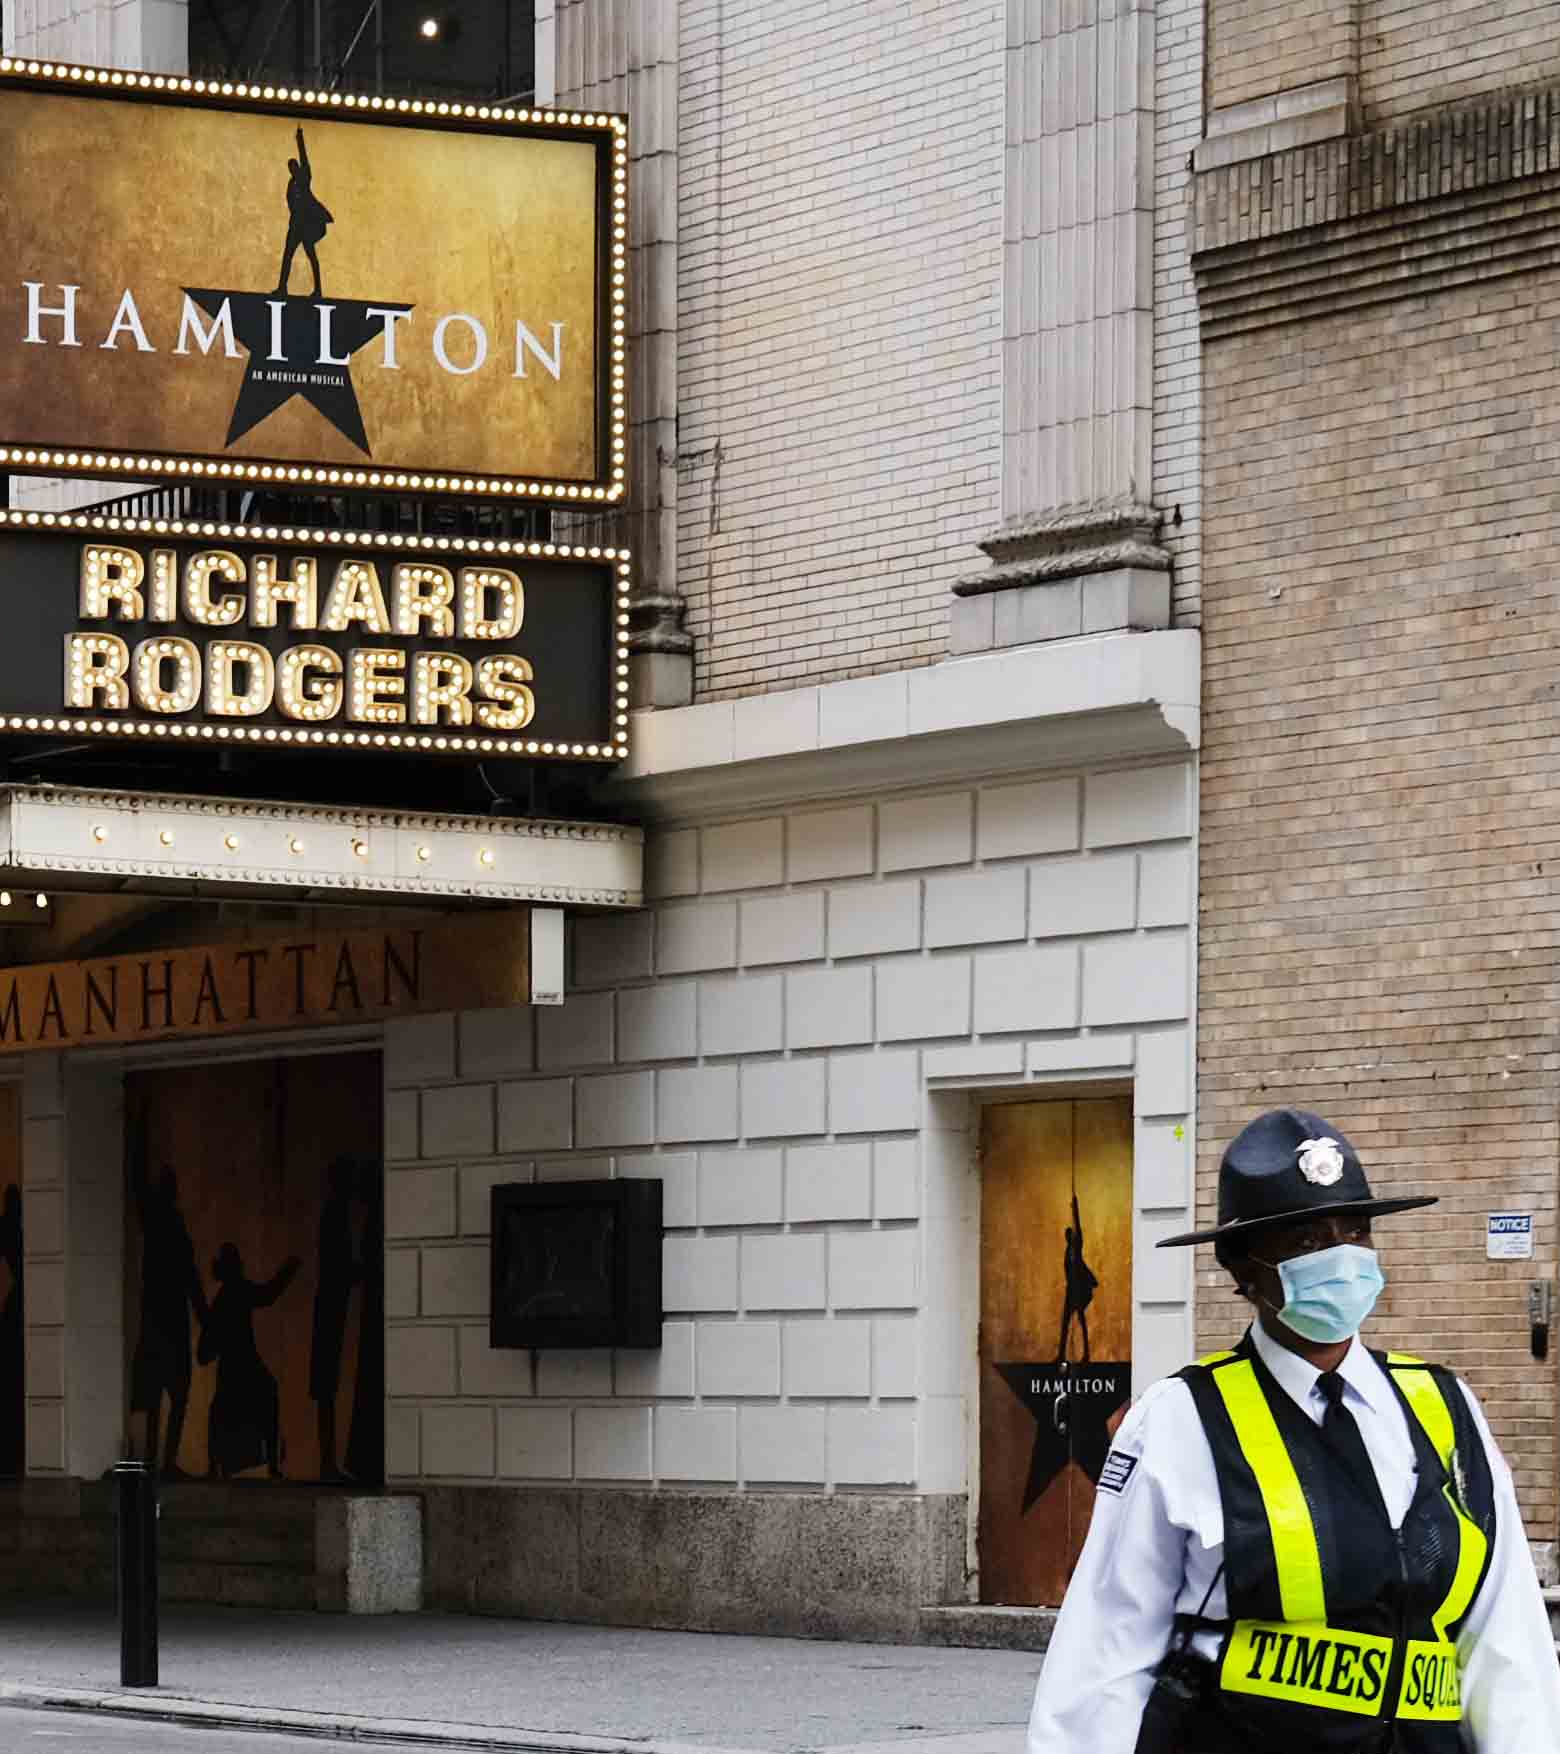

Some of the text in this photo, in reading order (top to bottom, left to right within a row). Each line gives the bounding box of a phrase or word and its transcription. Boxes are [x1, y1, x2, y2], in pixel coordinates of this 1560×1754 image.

[21, 280, 566, 382] HAMILTON
[252, 370, 345, 387] AN AMERICAN MUSICAL
[79, 543, 525, 641] RICHARD
[63, 631, 536, 731] RODGERS
[1490, 1218, 1529, 1231] NOTICE
[1031, 1378, 1116, 1394] HAMILTON
[1245, 1628, 1387, 1702] TIMES
